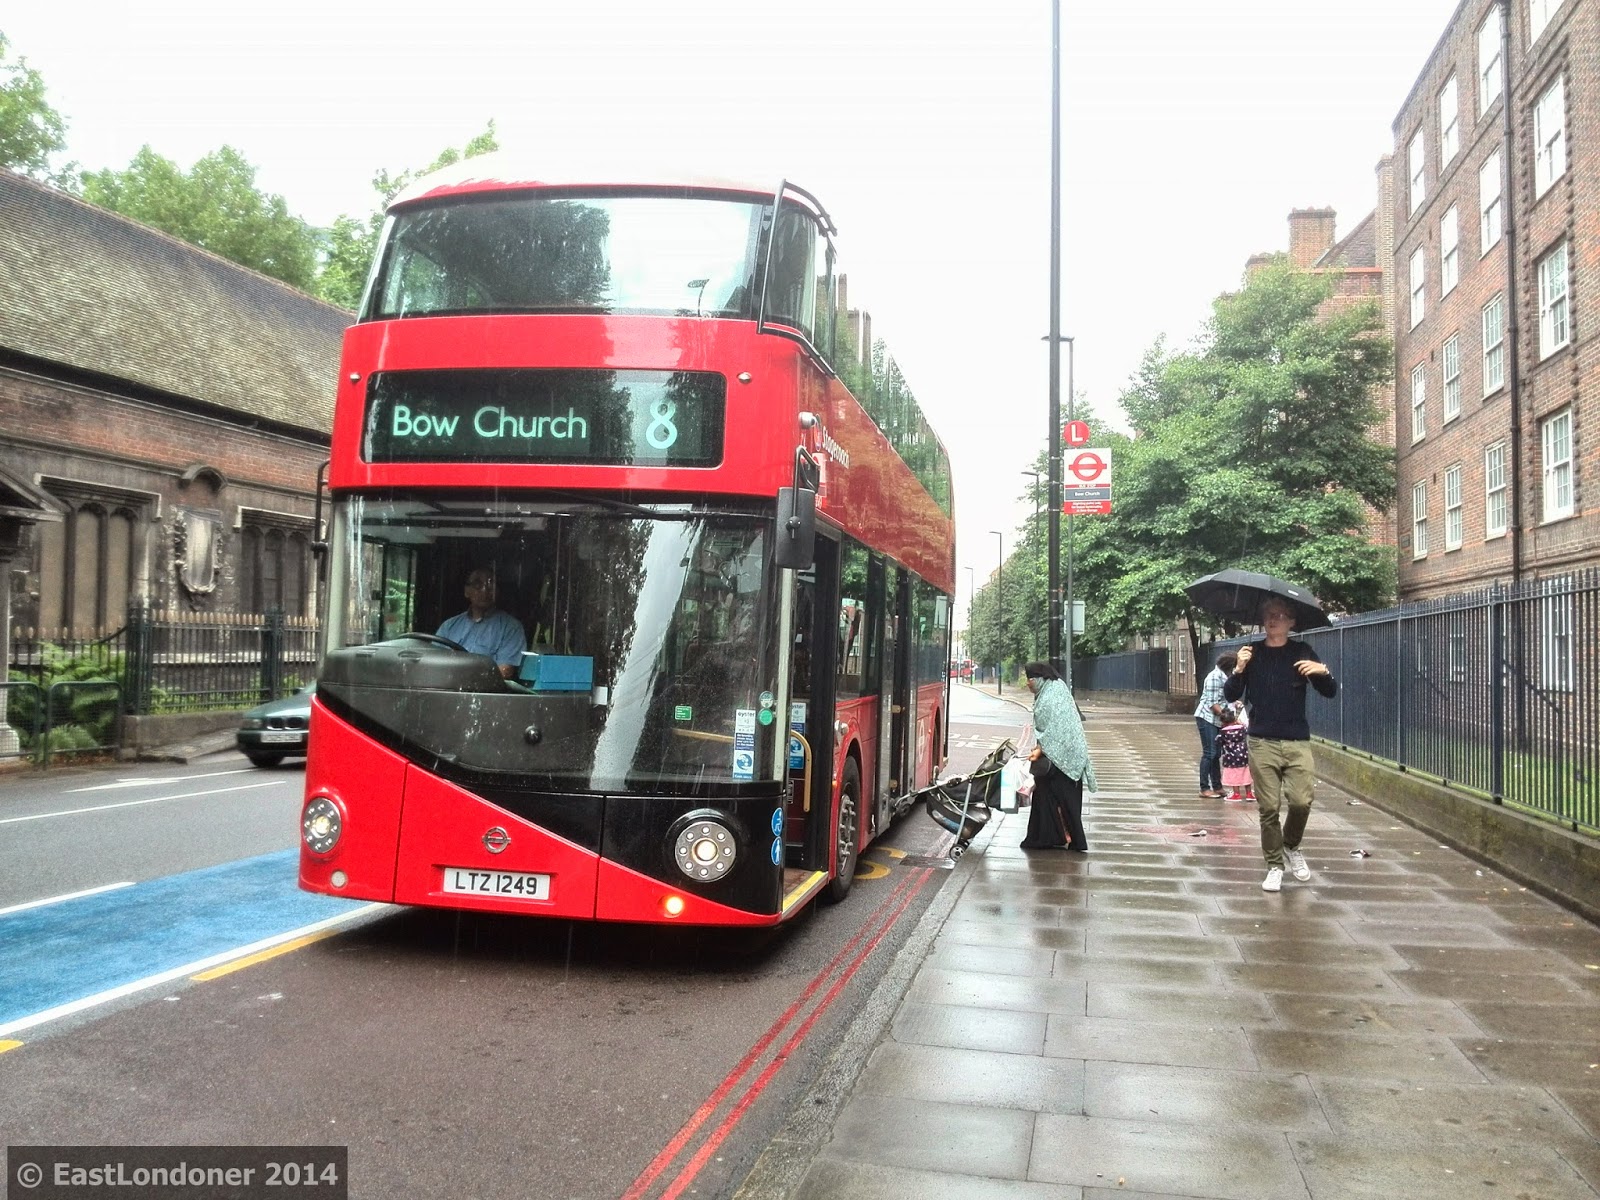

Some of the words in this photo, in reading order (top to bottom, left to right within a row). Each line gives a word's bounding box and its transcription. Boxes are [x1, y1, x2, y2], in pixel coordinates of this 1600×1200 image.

[393, 406, 459, 436] Bow
[474, 406, 587, 438] Church
[645, 401, 678, 449] 8
[1071, 424, 1084, 442] L
